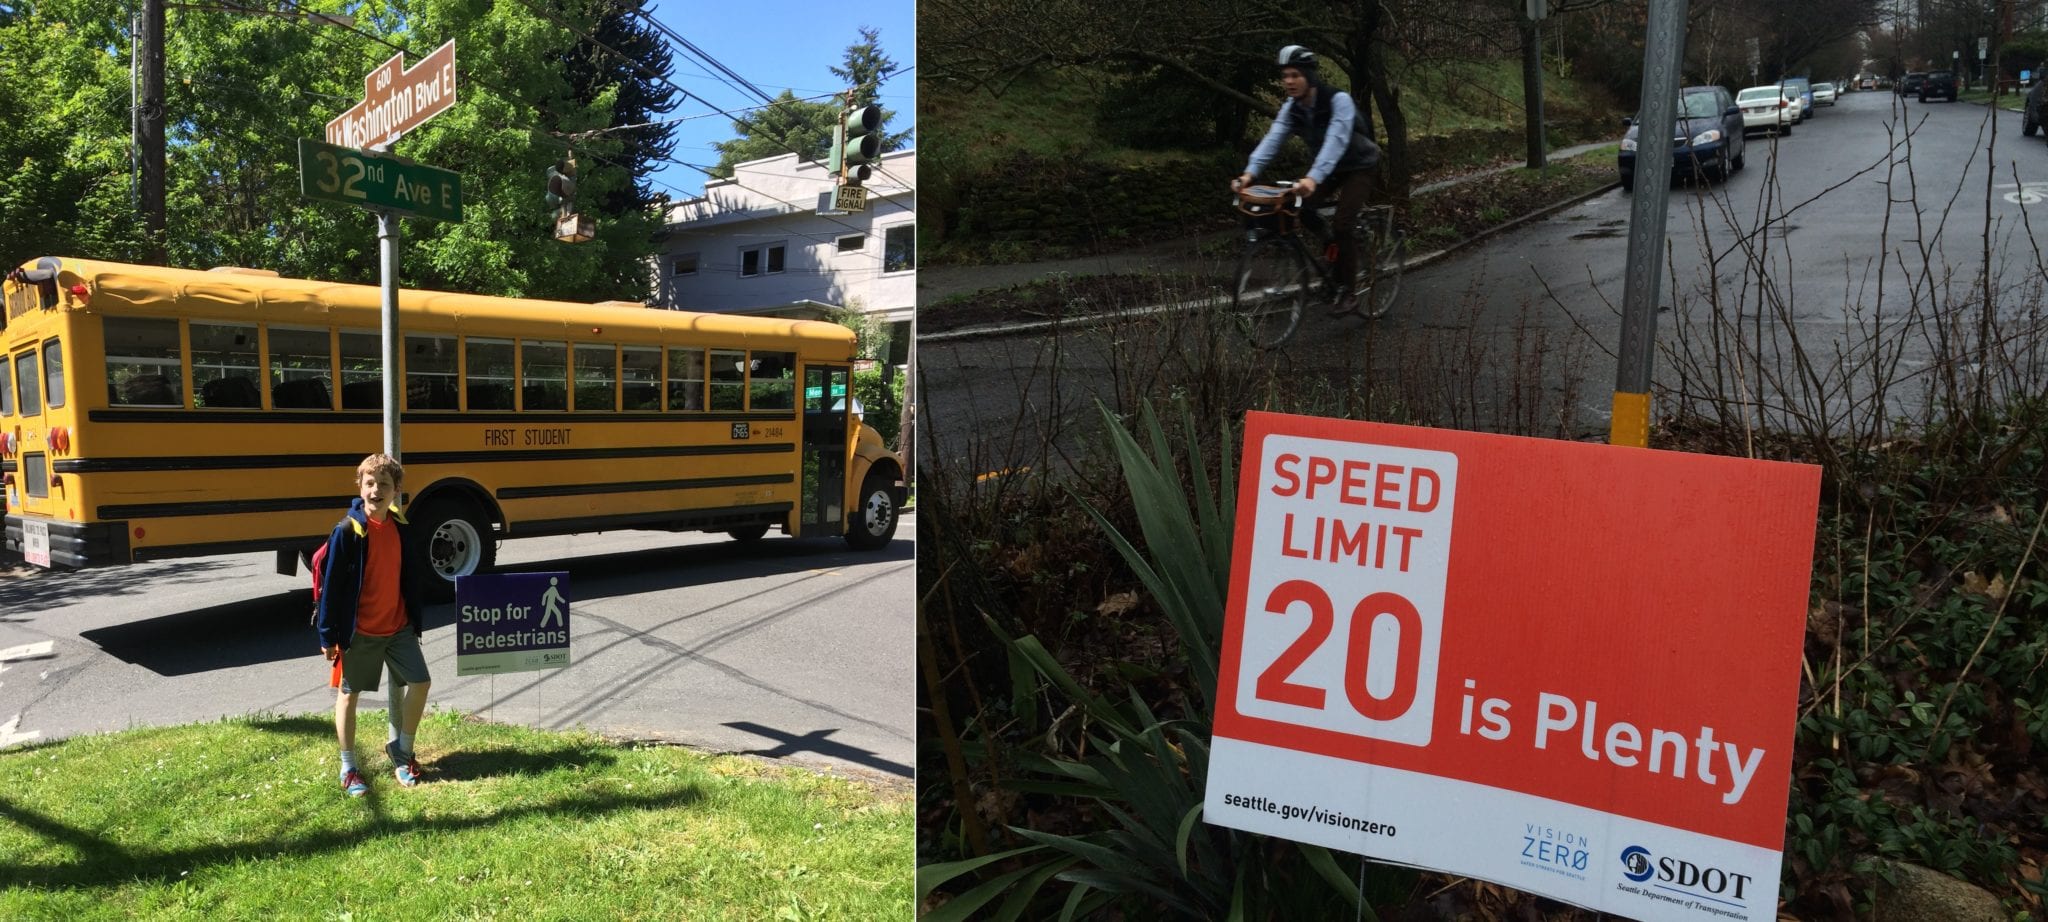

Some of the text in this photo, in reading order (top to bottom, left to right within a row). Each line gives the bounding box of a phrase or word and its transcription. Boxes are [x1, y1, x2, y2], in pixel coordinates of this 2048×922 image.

[376, 66, 392, 92] 600
[342, 85, 413, 150] Washington
[415, 71, 440, 113] Blvd
[443, 62, 452, 97] E
[316, 151, 453, 209] 32nd Ave E
[841, 187, 862, 199] FIRE
[836, 199, 864, 209] SIGNAL
[484, 428, 572, 446] FIRST STUDENT
[1271, 452, 1442, 514] SPEED
[1281, 513, 1423, 573] LIMIT
[461, 603, 532, 626] Stop for
[462, 628, 567, 651] Pedestrians
[1255, 579, 1423, 721] 20
[1460, 678, 1766, 805] is Plenty
[1224, 792, 1397, 838] seattle.gov/visionzero
[1526, 823, 1588, 848] VISION
[1657, 856, 1753, 901] SDOT
[1616, 882, 1749, 922] Seattle Department of Transportation
